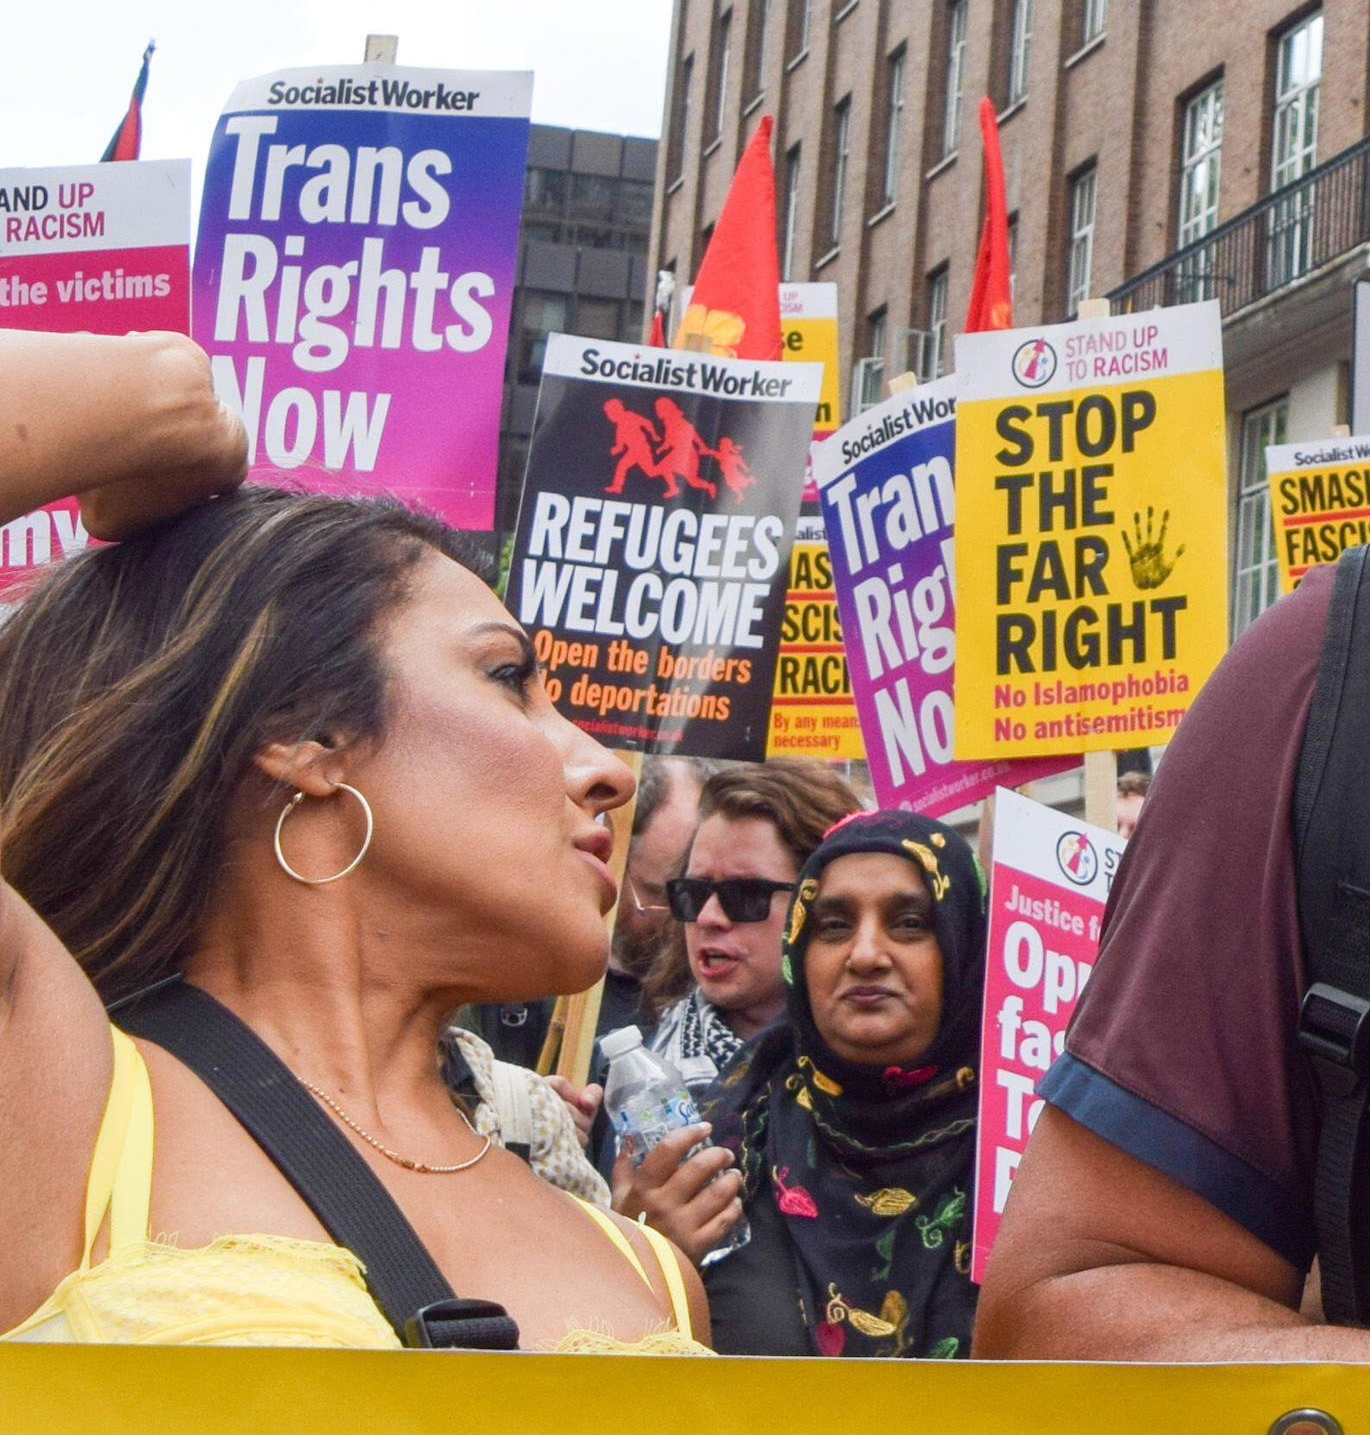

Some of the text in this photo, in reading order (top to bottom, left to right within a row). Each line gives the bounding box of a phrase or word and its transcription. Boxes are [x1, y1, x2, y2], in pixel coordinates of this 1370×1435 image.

[58, 182, 95, 209] UP
[225, 115, 453, 230] Trans
[6, 211, 105, 243] RACISM
[0, 268, 171, 307] the victims
[213, 233, 496, 373] Rights
[1065, 325, 1159, 358] STAND UP
[1065, 347, 1168, 382] TO RACISM
[995, 390, 1157, 466] STOP
[995, 463, 1115, 535] THE
[527, 491, 784, 581] REFUGEES
[996, 534, 1110, 606] FAR
[519, 557, 772, 649] WELCOME
[534, 629, 752, 684] Open the borders
[996, 595, 1188, 676] RIGHT
[569, 673, 731, 721] deportations
[994, 668, 1190, 709] No Islamophobia
[774, 712, 789, 732] By
[795, 717, 817, 733] any
[774, 734, 841, 751] necessary
[994, 704, 1187, 742] No antisemitism
[1004, 884, 1085, 936] Justice
